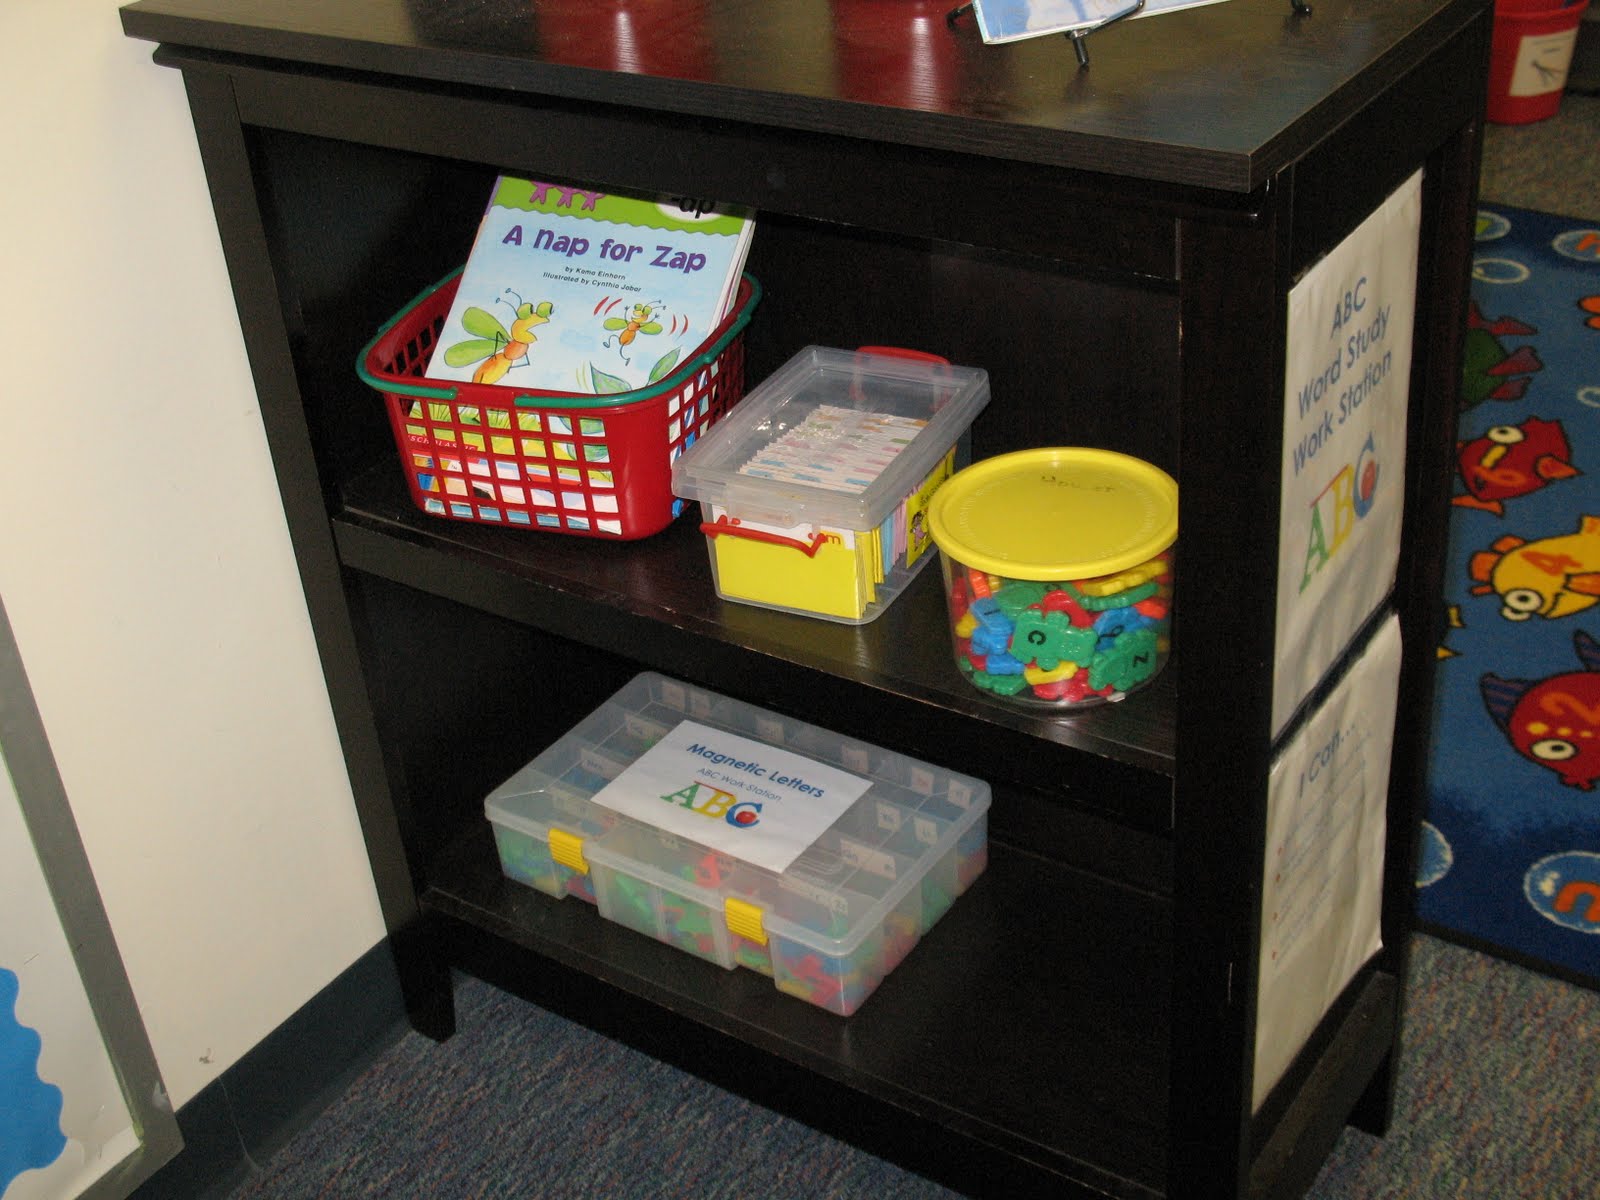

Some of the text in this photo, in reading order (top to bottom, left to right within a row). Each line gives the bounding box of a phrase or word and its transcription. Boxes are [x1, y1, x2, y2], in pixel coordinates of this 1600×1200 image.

[502, 225, 523, 246] A
[600, 238, 643, 263] for
[649, 245, 707, 274] Zap
[565, 266, 626, 281] by Kama Einhorn
[543, 272, 579, 283] Illustrated
[580, 277, 590, 286] by
[591, 279, 620, 290] Cynthia
[1331, 276, 1367, 339] ABC
[1298, 304, 1391, 419] Word Study
[1293, 350, 1392, 475] Work Station
[1299, 431, 1381, 594] ABC
[1520, 550, 1583, 576] 4
[686, 743, 825, 798] Magnetic Letters
[697, 768, 721, 780] ABC
[660, 781, 763, 828] ABC
